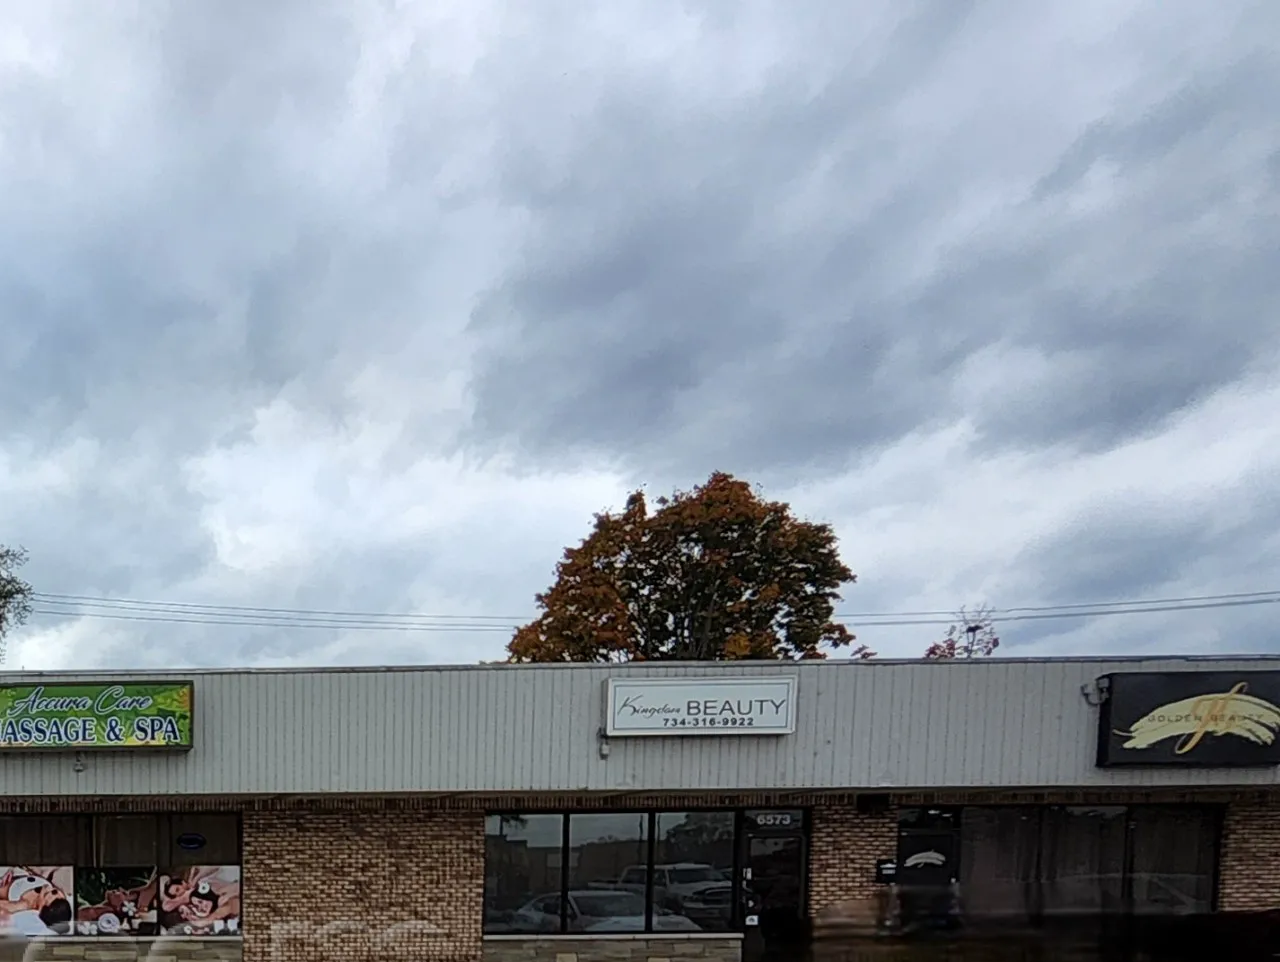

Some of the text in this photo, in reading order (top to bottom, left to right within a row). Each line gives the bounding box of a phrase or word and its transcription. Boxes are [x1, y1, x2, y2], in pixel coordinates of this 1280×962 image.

[8, 685, 153, 716] Accura Care
[686, 699, 787, 716] BEAUTY
[662, 717, 754, 727] 734-316-9922
[1147, 714, 1203, 723] GOLDEN
[105, 716, 124, 744] &
[133, 716, 181, 743] SPA
[756, 814, 791, 825] 6573
